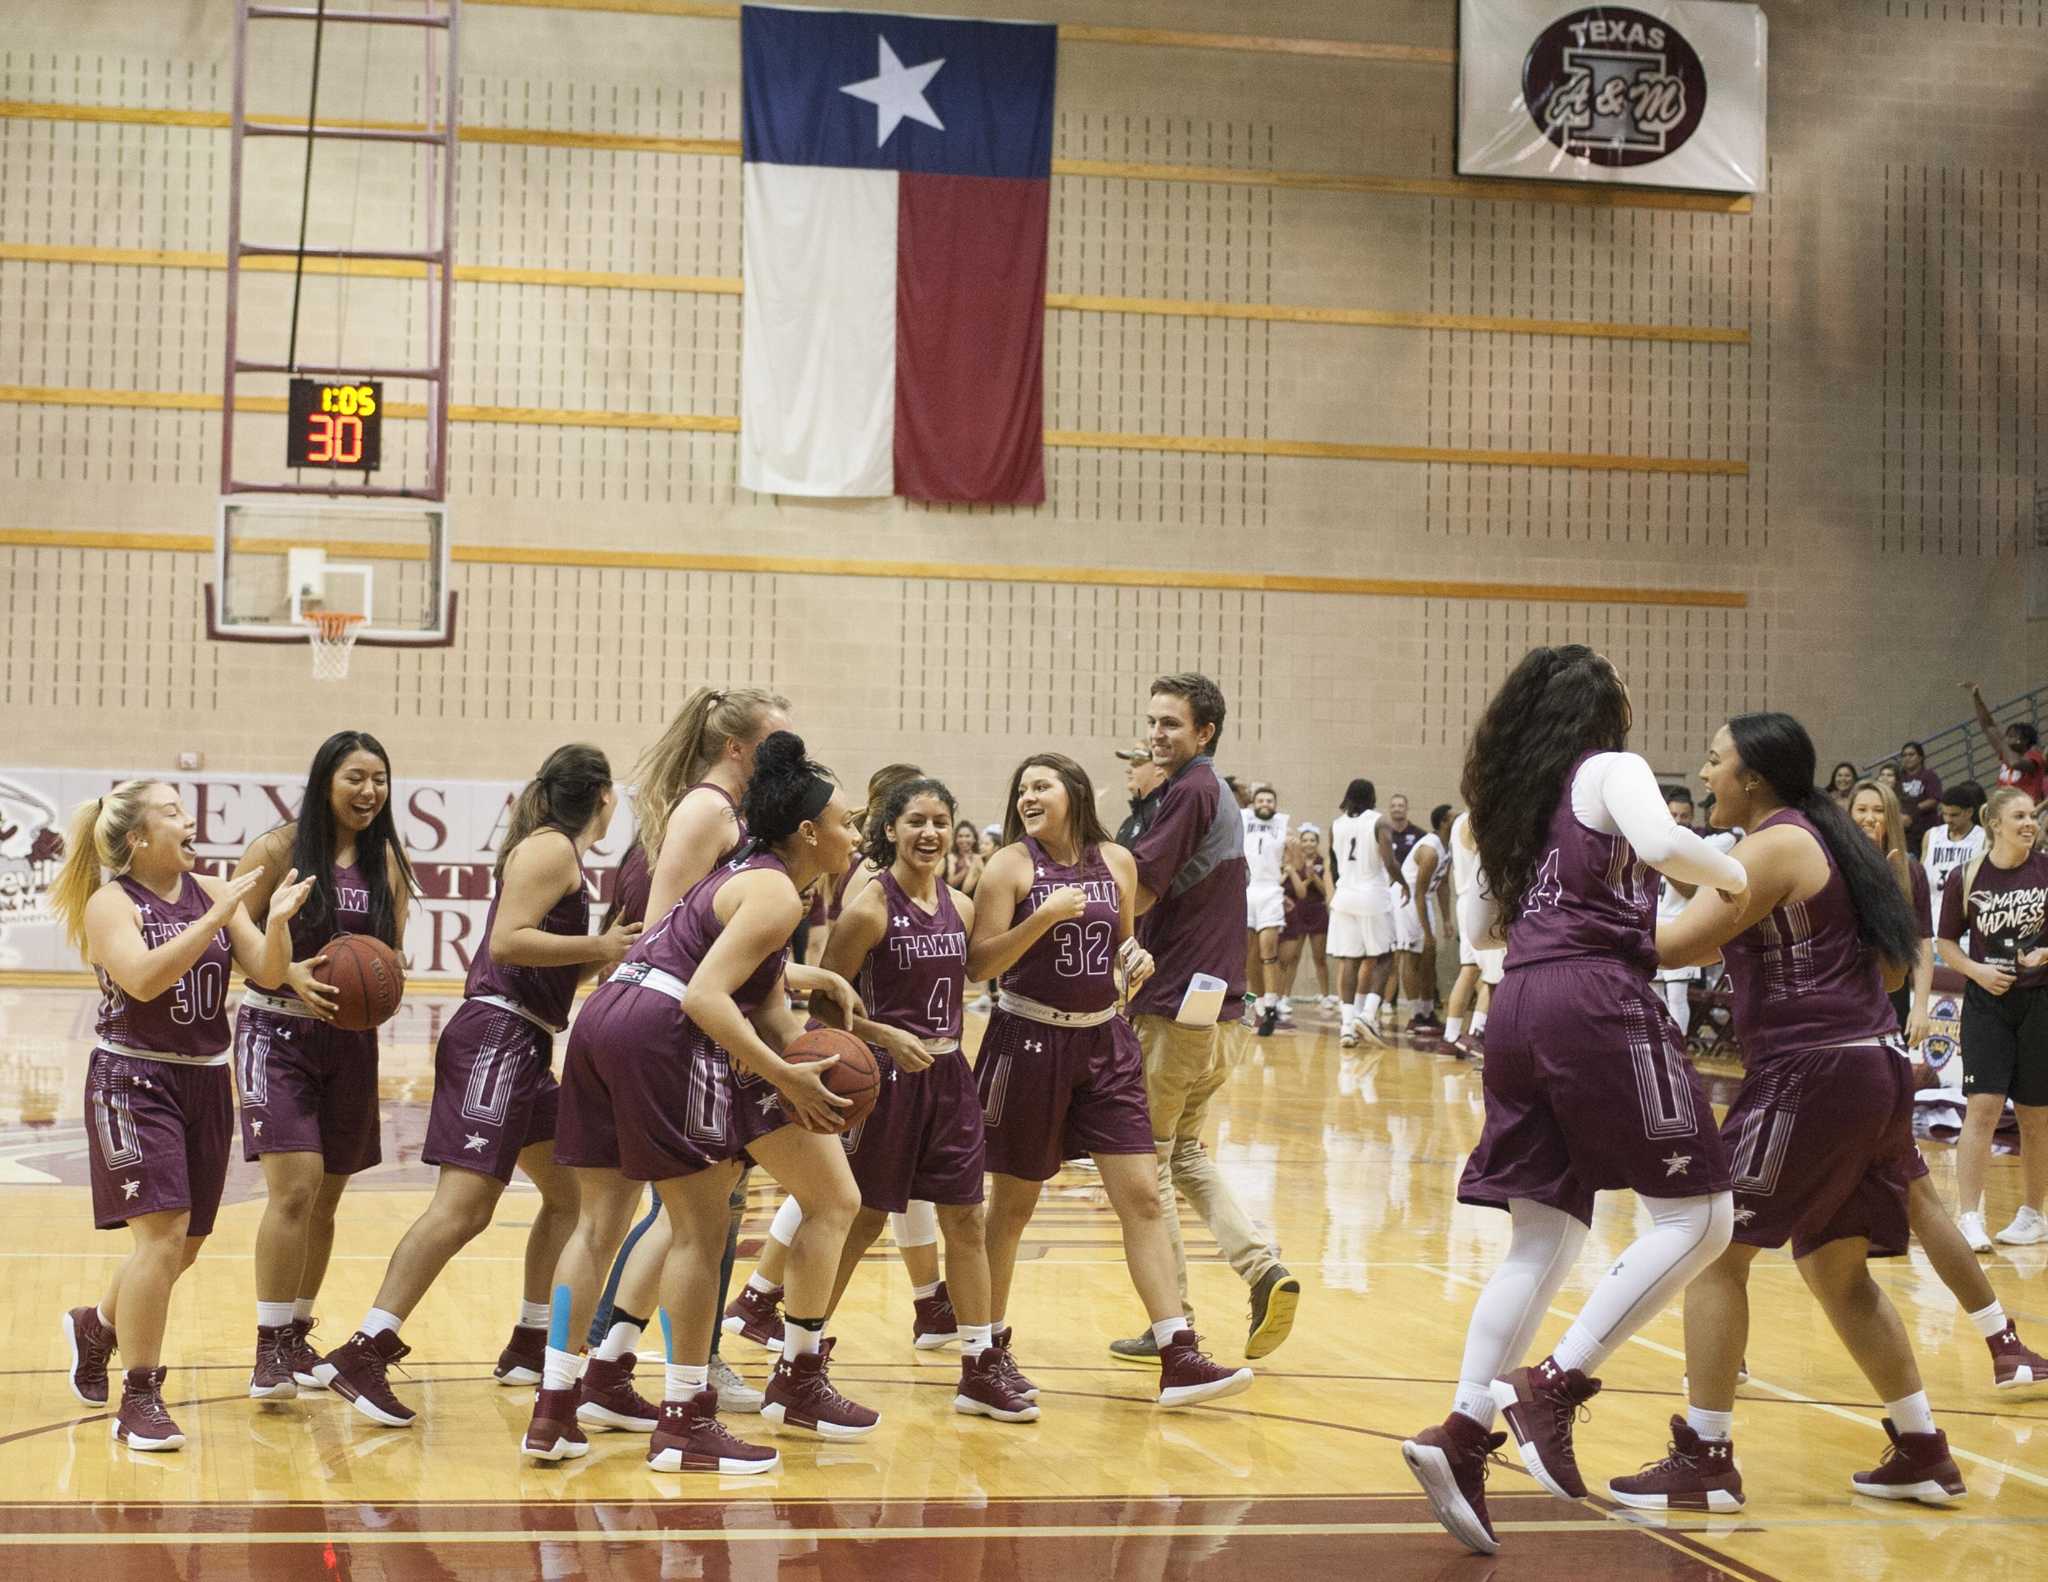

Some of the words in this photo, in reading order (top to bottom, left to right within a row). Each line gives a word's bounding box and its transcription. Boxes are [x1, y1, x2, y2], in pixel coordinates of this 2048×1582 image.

[1568, 19, 1666, 49] TEXAS
[322, 385, 376, 416] 1:05
[308, 413, 363, 462] 30
[1975, 902, 2045, 937] MADNESS
[1991, 886, 2048, 912] MAROON
[1053, 920, 1113, 978] 32
[170, 962, 223, 1025] 30
[927, 976, 952, 1031] 4
